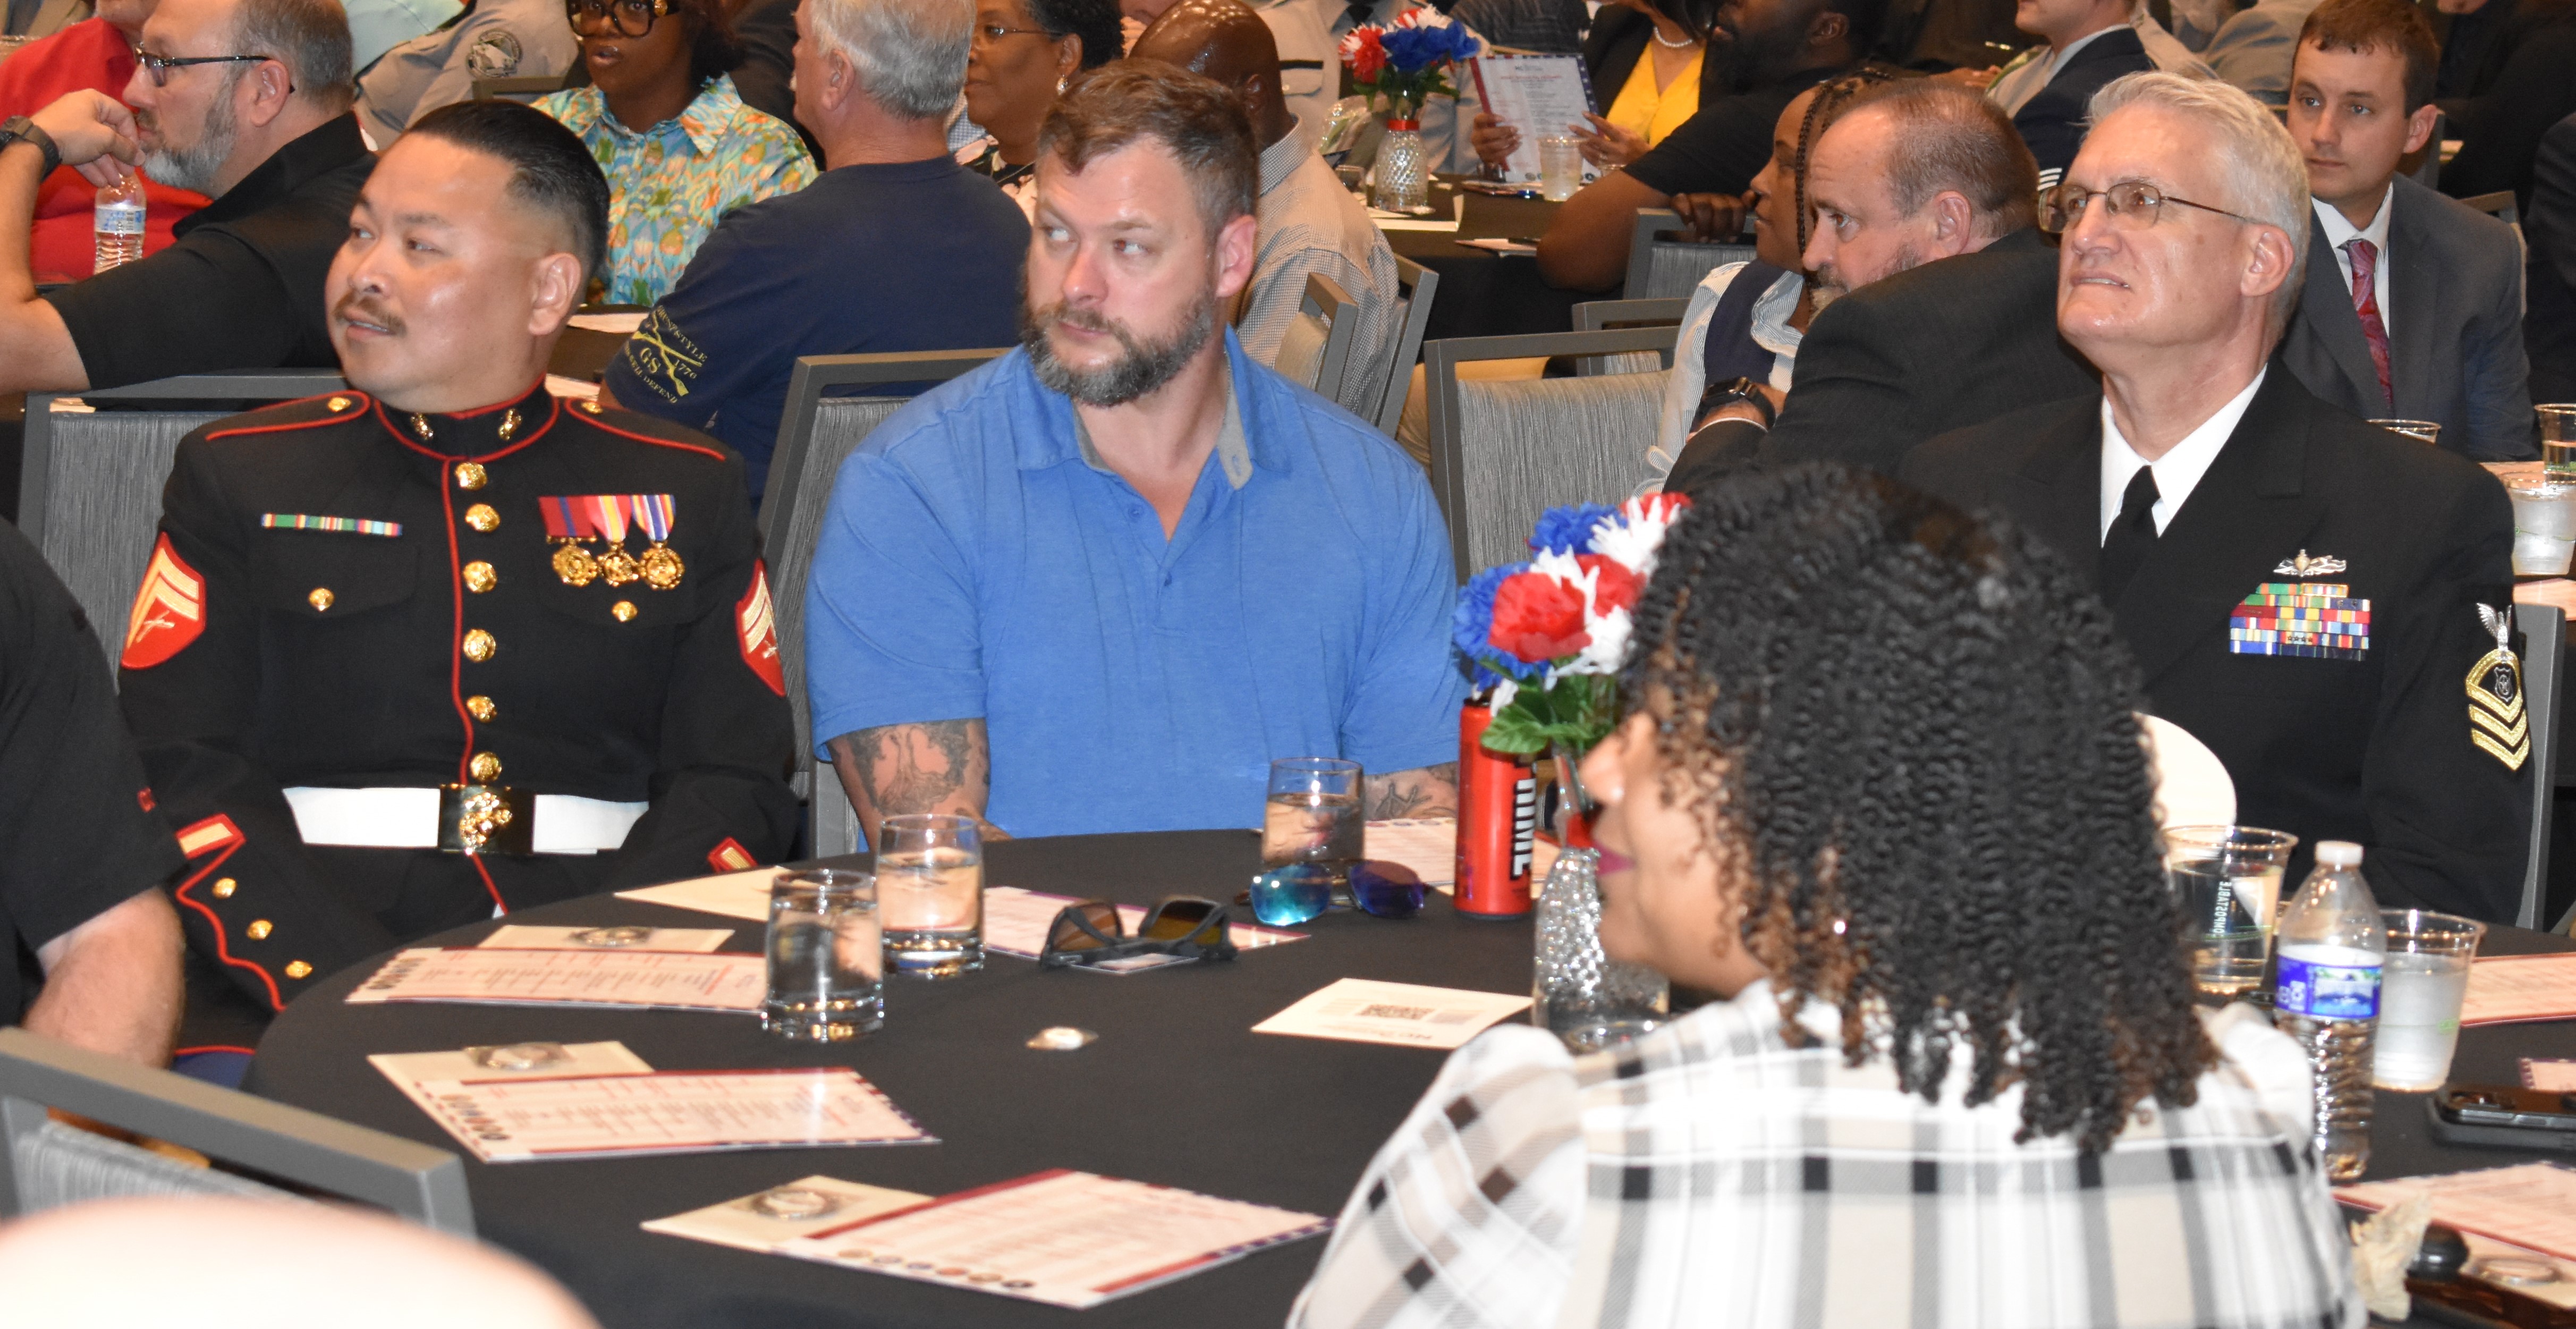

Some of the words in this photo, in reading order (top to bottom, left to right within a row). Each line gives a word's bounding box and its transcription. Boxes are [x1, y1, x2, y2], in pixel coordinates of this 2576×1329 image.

[674, 330, 708, 362] STYLE
[640, 347, 662, 374] GS
[673, 359, 697, 379] 1776
[643, 375, 678, 403] DEFEND
